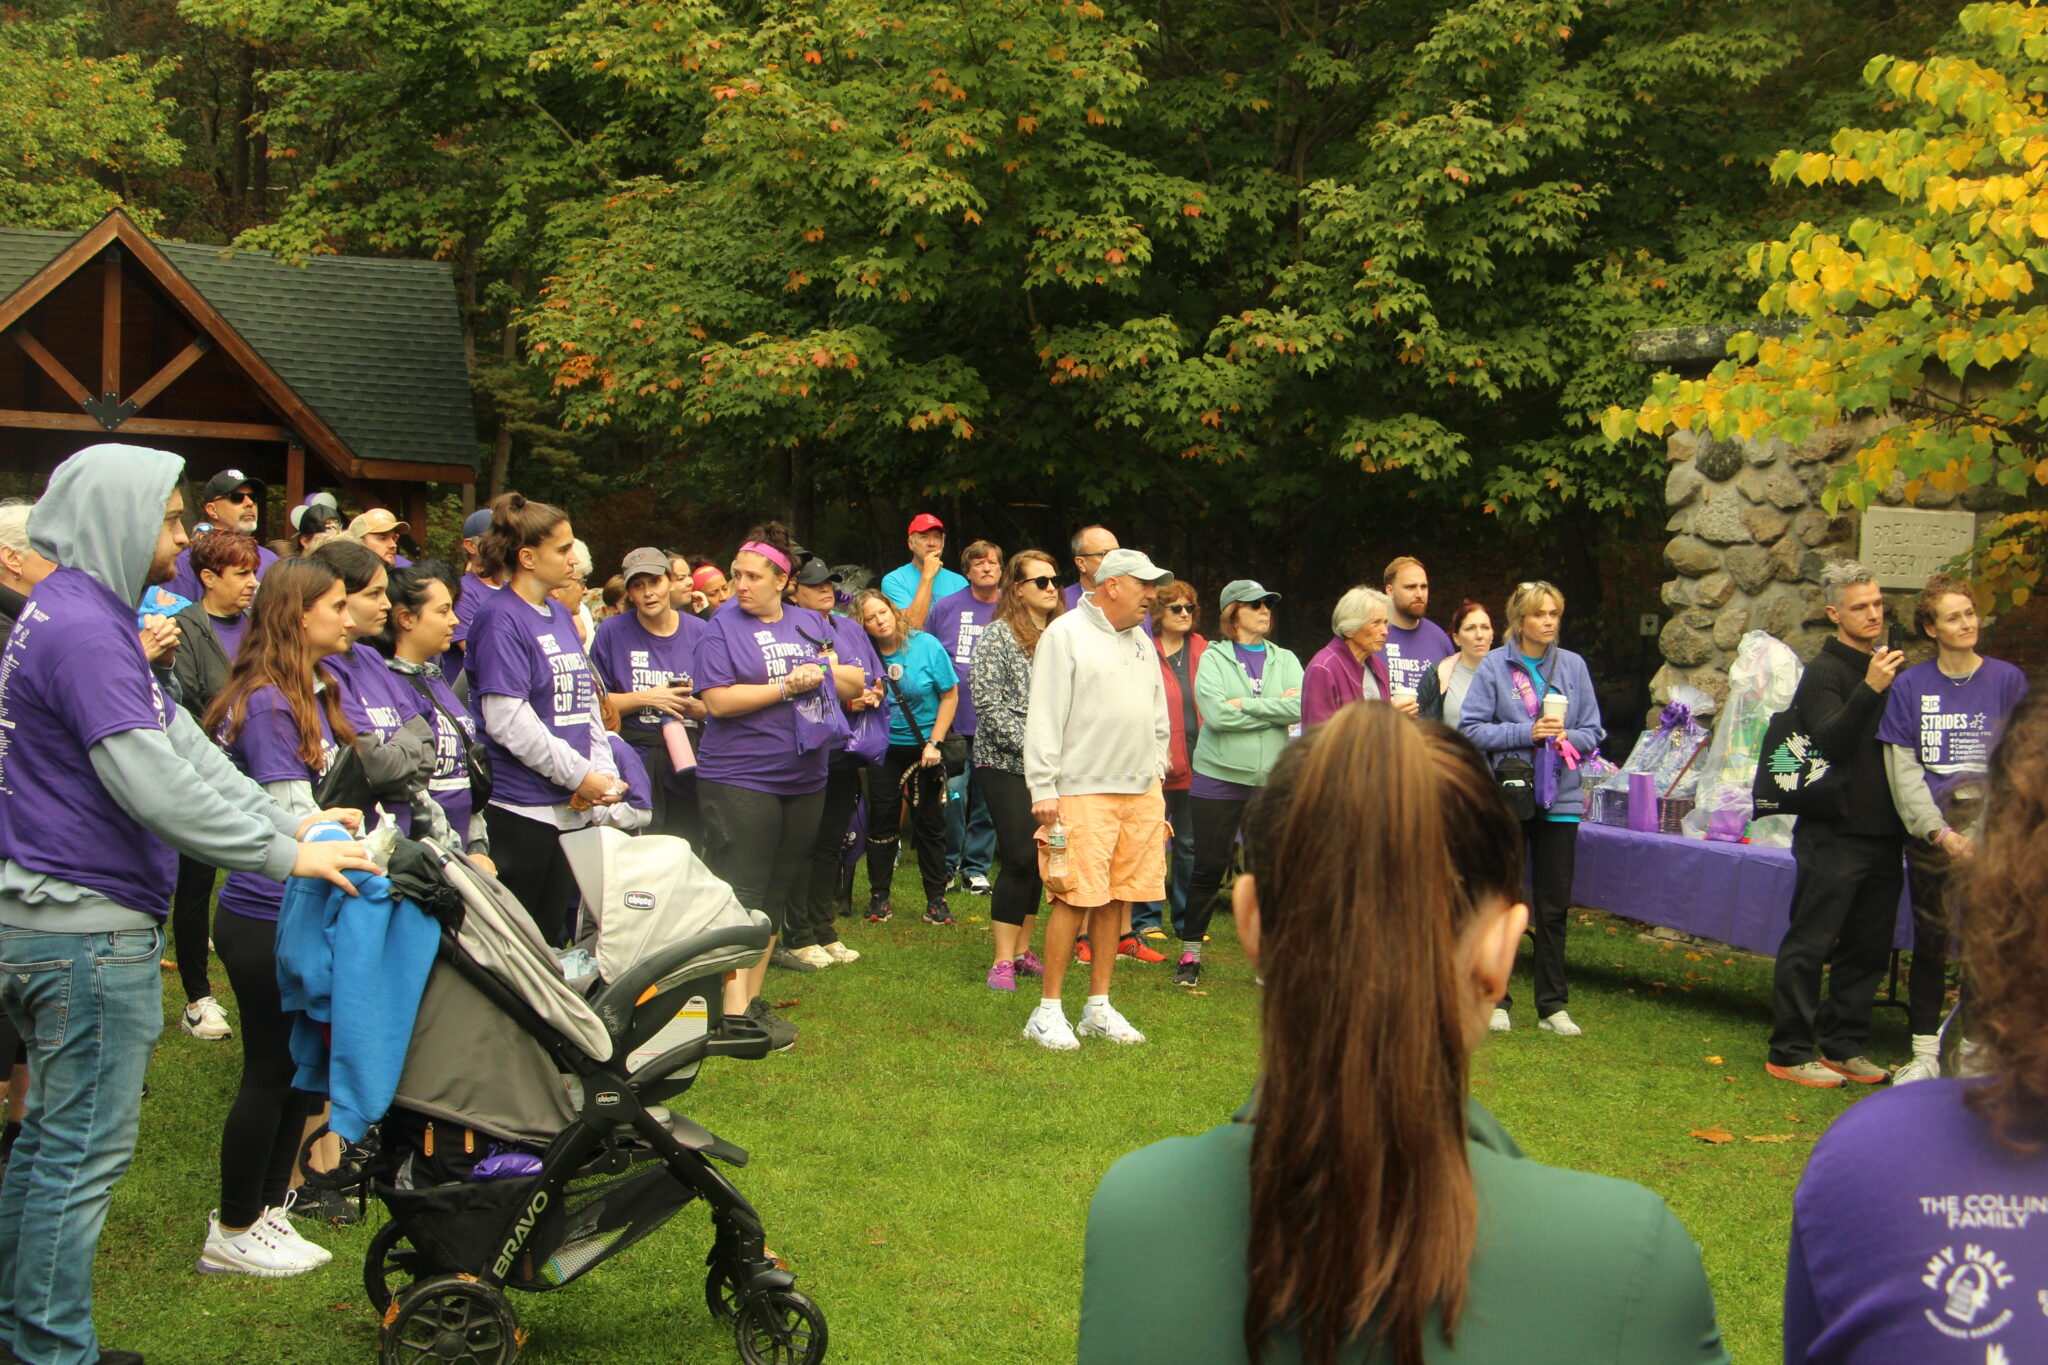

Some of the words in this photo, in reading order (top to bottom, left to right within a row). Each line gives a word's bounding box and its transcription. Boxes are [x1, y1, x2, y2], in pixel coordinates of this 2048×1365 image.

[1873, 523, 1968, 552] BREAKHEART
[960, 624, 983, 636] STRID
[761, 643, 804, 660] STRIDES
[765, 658, 788, 677] FOR
[1388, 657, 1420, 671] STRIDES
[553, 673, 574, 693] FOR
[1389, 670, 1404, 682] FOR
[553, 693, 573, 712] CJD
[1921, 713, 1968, 730] STRIDES
[437, 735, 457, 757] FOR
[1921, 730, 1942, 746] FOR
[1921, 746, 1941, 762] CJD
[433, 757, 455, 776] CJD
[1919, 1195, 1960, 1215] THE
[1948, 1211, 2030, 1230] FAMILY
[492, 1191, 549, 1279] BRAVO
[1921, 1245, 1955, 1290] AMY
[1964, 1243, 2016, 1290] HALL
